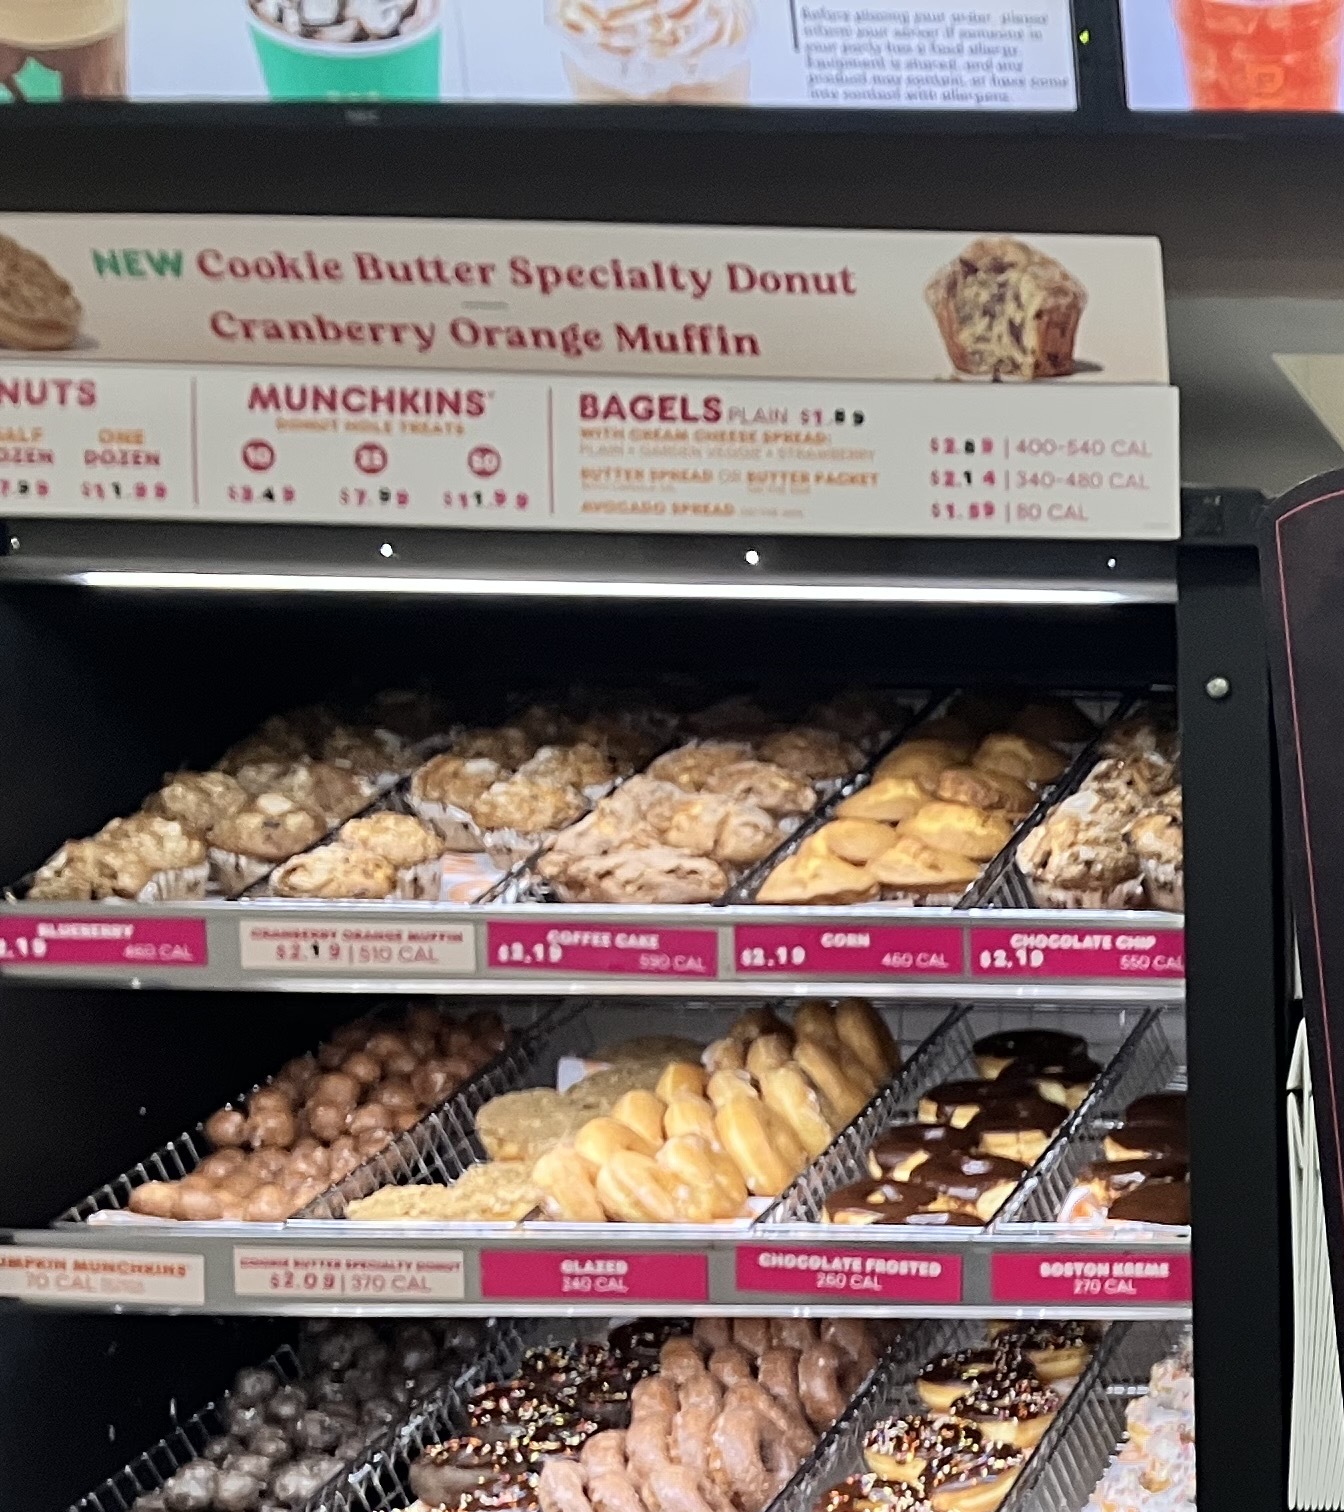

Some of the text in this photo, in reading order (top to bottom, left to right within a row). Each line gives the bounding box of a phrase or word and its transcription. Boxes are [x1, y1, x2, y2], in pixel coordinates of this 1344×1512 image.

[91, 247, 857, 299] NEW Cookie Butter Specialty Donut
[210, 310, 761, 357] Cranberry Orange Muffin
[247, 383, 486, 416] MUNCHKINS
[579, 391, 789, 426] BAGELS PLAIN
[1016, 437, 1152, 459] 400-540 CAL
[84, 449, 161, 467] DOZEN
[1109, 471, 1150, 490] CAL
[1047, 503, 1088, 522] CAL
[547, 929, 660, 949] COFFEE CAKE
[820, 932, 871, 949] CORN
[1010, 933, 1156, 951] CHOCOLATE CHIP
[158, 943, 193, 961] CAL
[399, 946, 438, 963] CAL
[915, 952, 949, 969] CAL
[672, 954, 706, 973] CAL
[1152, 955, 1185, 971] CAL
[73, 1260, 187, 1277] MUNCHKINS
[560, 1259, 629, 1275] GLAZED
[758, 1252, 942, 1278] CHOCOLATE FROSTED
[1039, 1262, 1170, 1278] BOSTON KREME
[56, 1273, 96, 1292] CAL
[352, 1274, 386, 1292] 370
[391, 1275, 431, 1293] CAL
[594, 1276, 629, 1293] CAL
[849, 1273, 883, 1291] CAL
[1104, 1278, 1137, 1295] CAL
